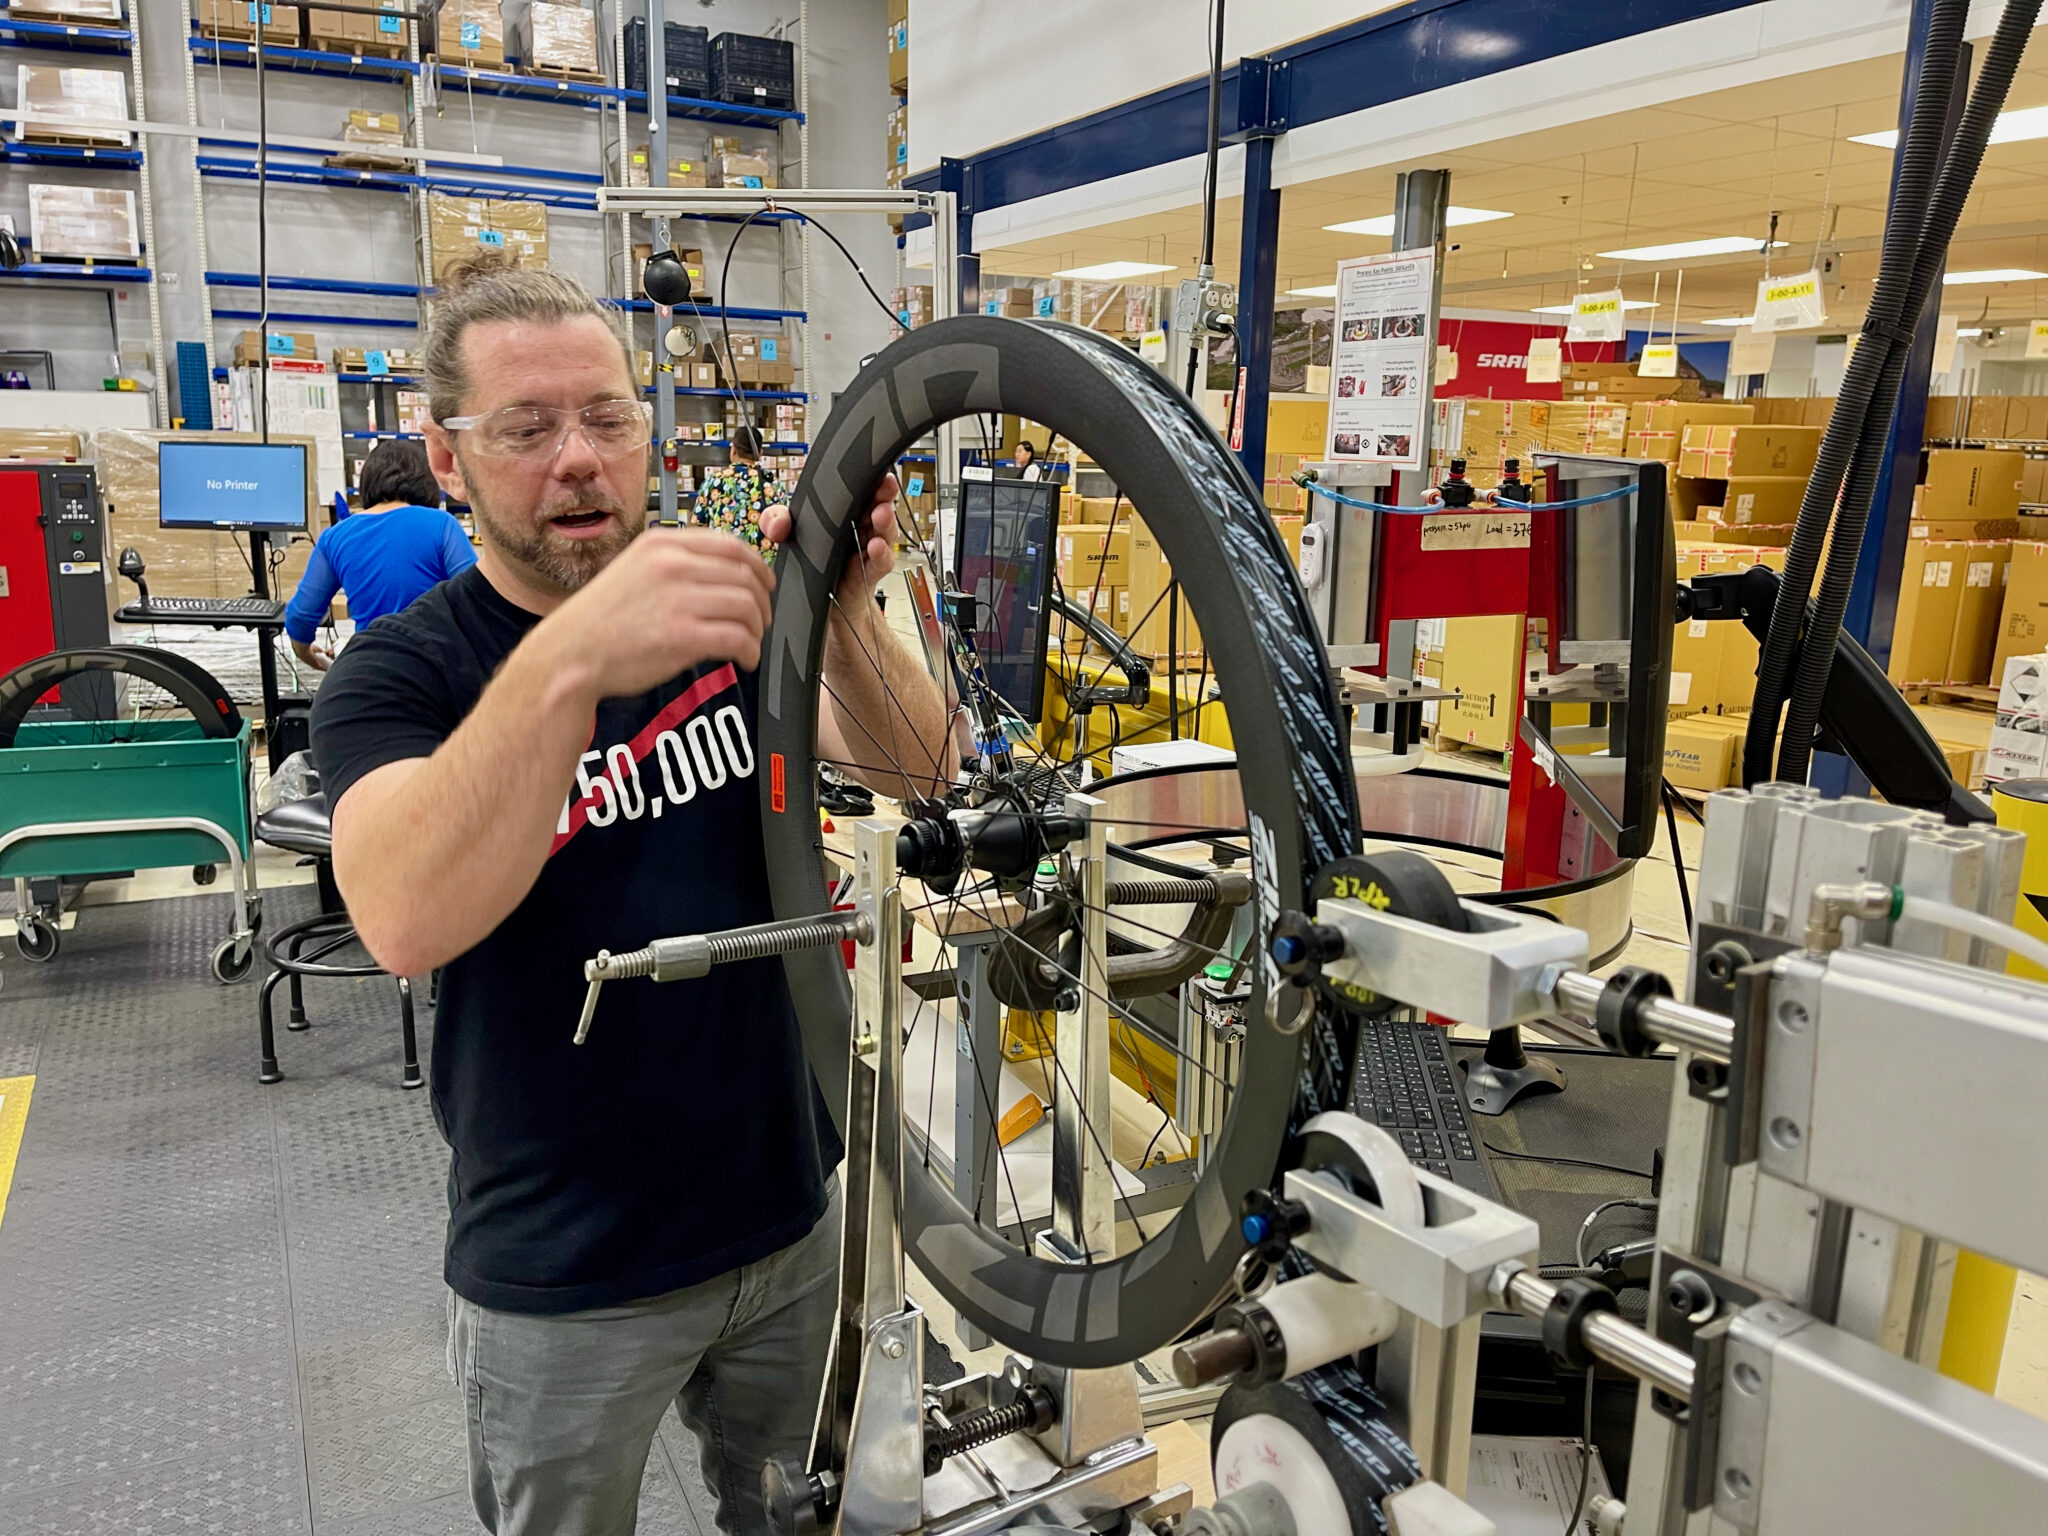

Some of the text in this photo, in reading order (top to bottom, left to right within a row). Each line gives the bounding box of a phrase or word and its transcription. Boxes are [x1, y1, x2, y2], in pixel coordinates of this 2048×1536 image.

[1477, 353, 1529, 369] SRA
[206, 479, 259, 491] No Printer
[1463, 692, 1489, 703] AUTION
[1301, 751, 1348, 819] ZIPP
[1326, 1416, 1392, 1476] ZIPP
